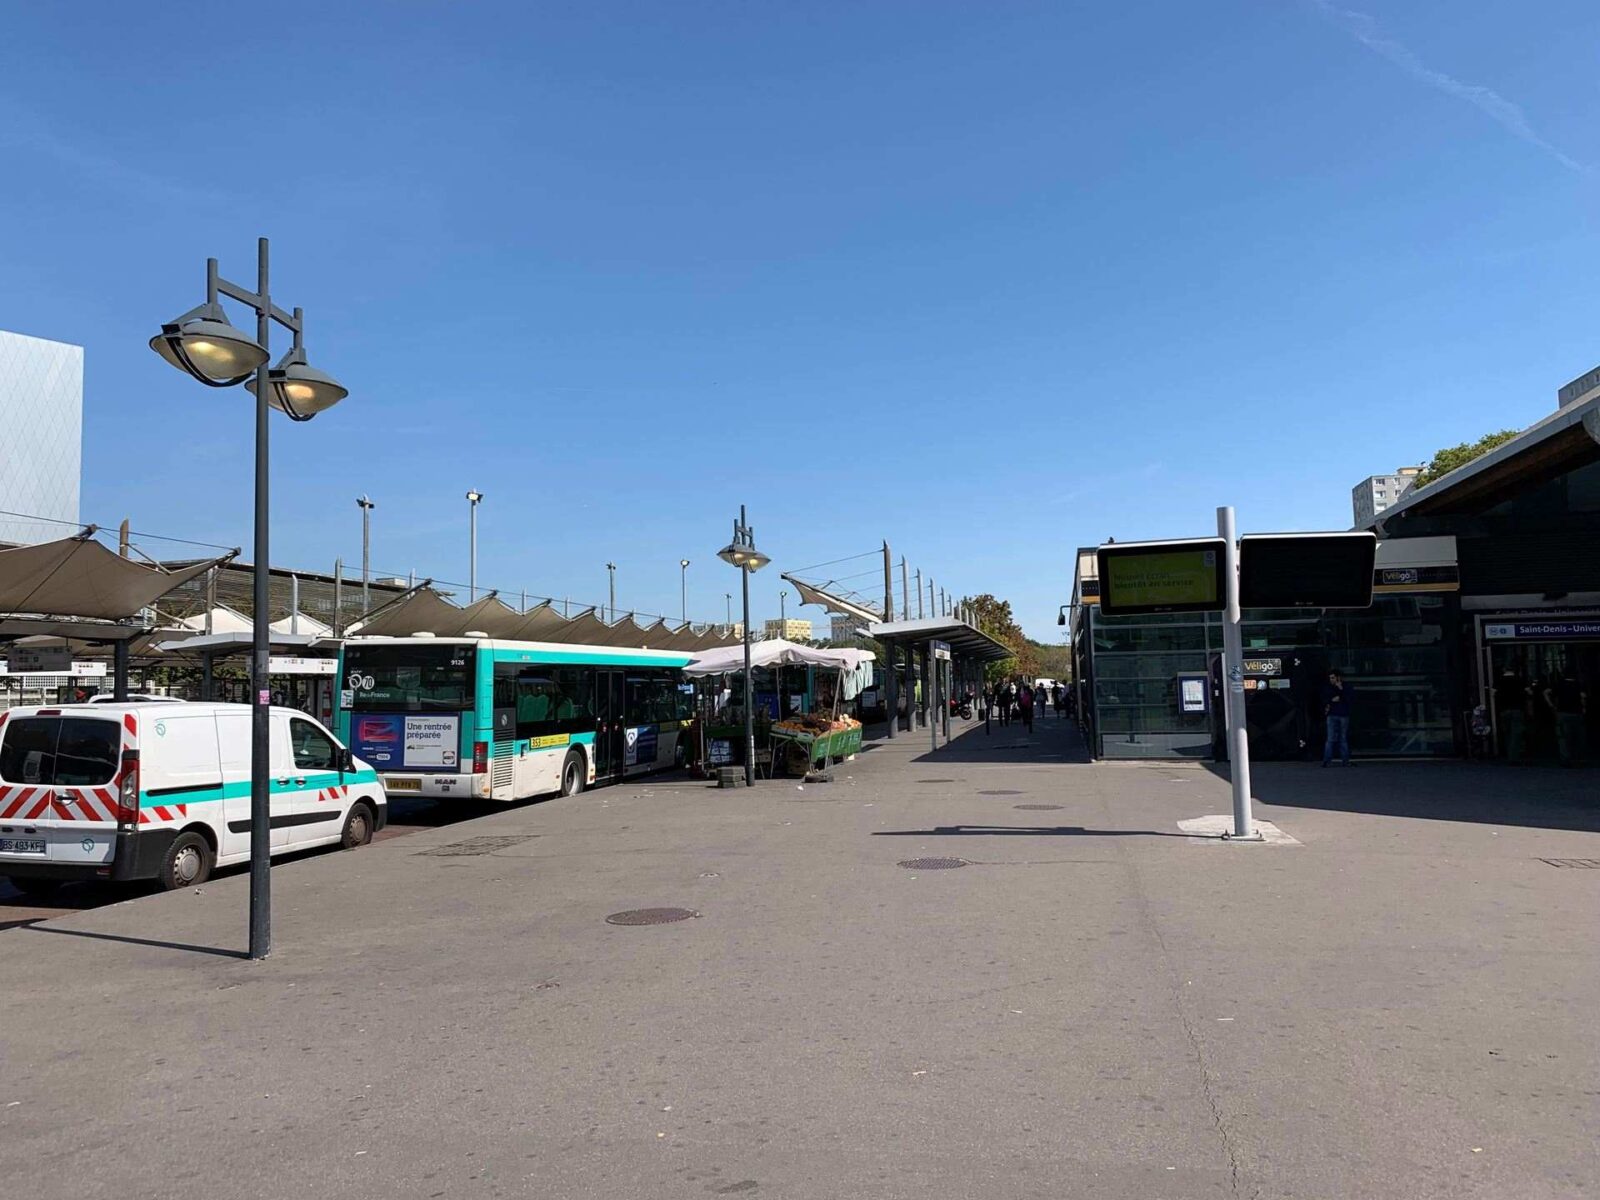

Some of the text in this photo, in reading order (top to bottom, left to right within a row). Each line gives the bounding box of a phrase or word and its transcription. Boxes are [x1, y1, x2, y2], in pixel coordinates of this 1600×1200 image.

[406, 722, 452, 731] Une rentrée
[406, 731, 441, 740] préparée
[531, 737, 541, 748] 353
